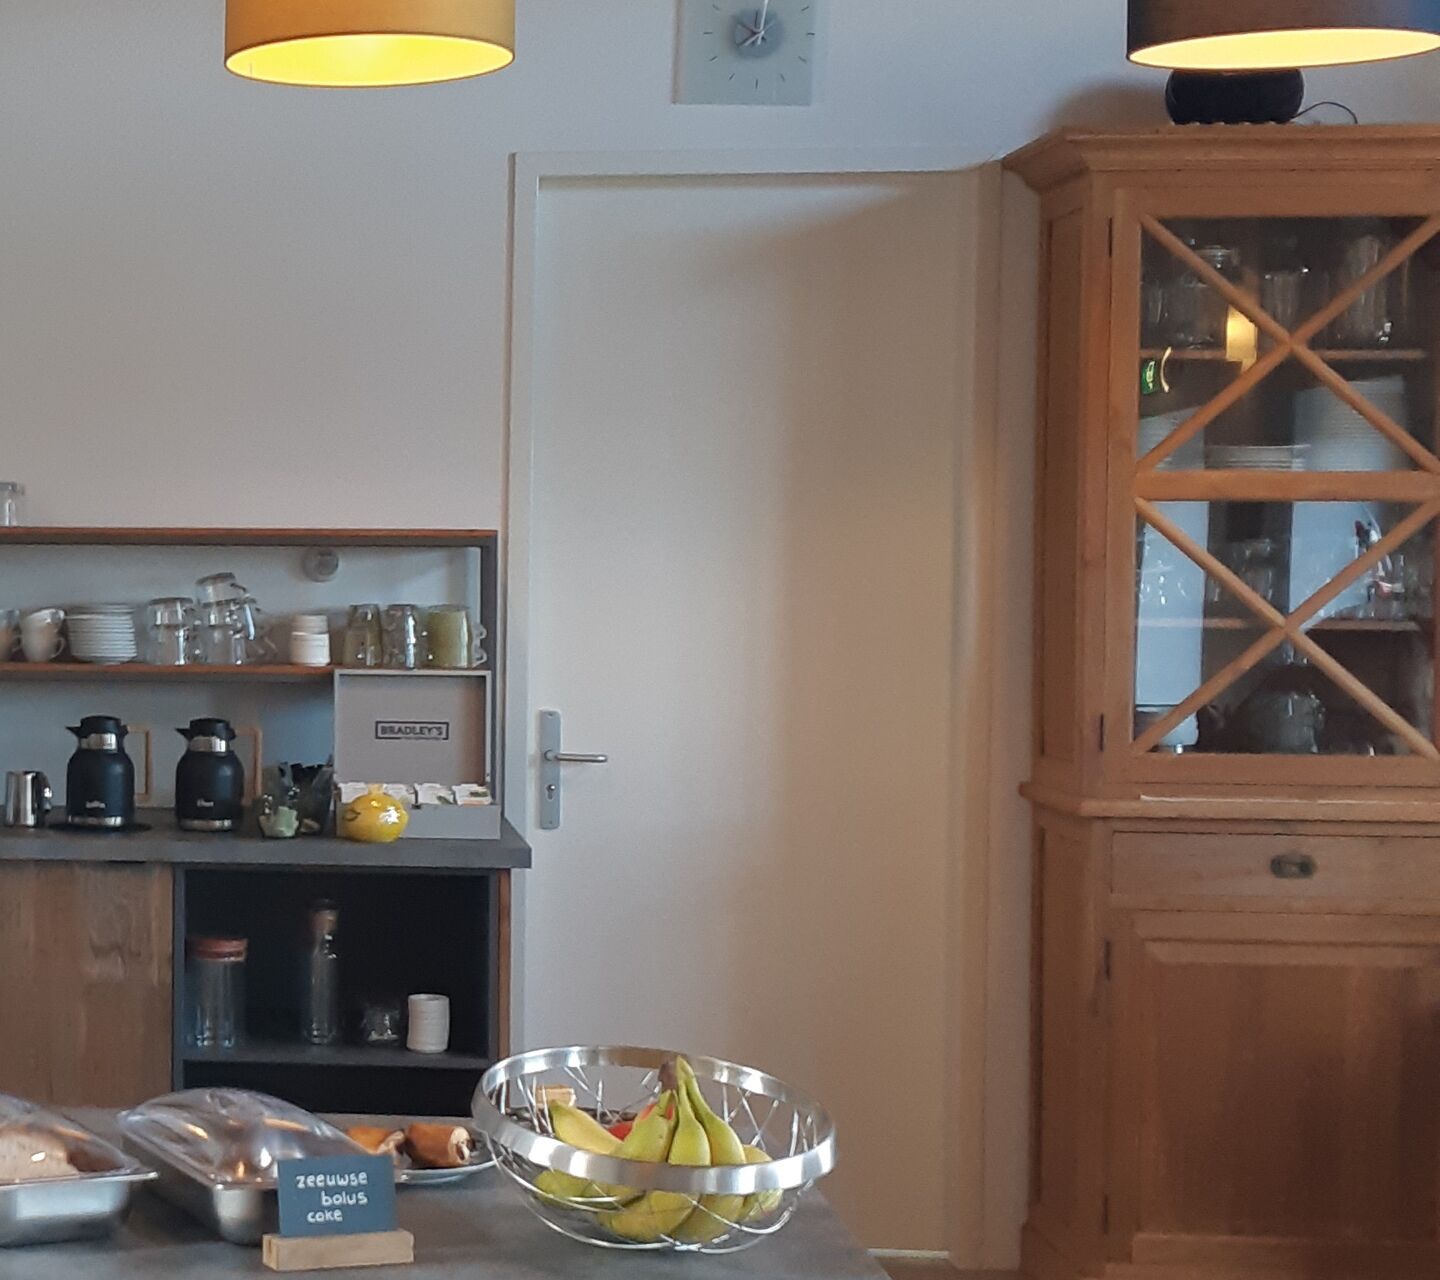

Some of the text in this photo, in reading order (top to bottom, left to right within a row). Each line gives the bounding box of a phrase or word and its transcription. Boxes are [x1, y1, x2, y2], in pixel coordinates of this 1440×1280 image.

[380, 725, 444, 736] BRADLEY'S
[295, 1171, 368, 1189] zeeuwse
[321, 1190, 368, 1206] bolus
